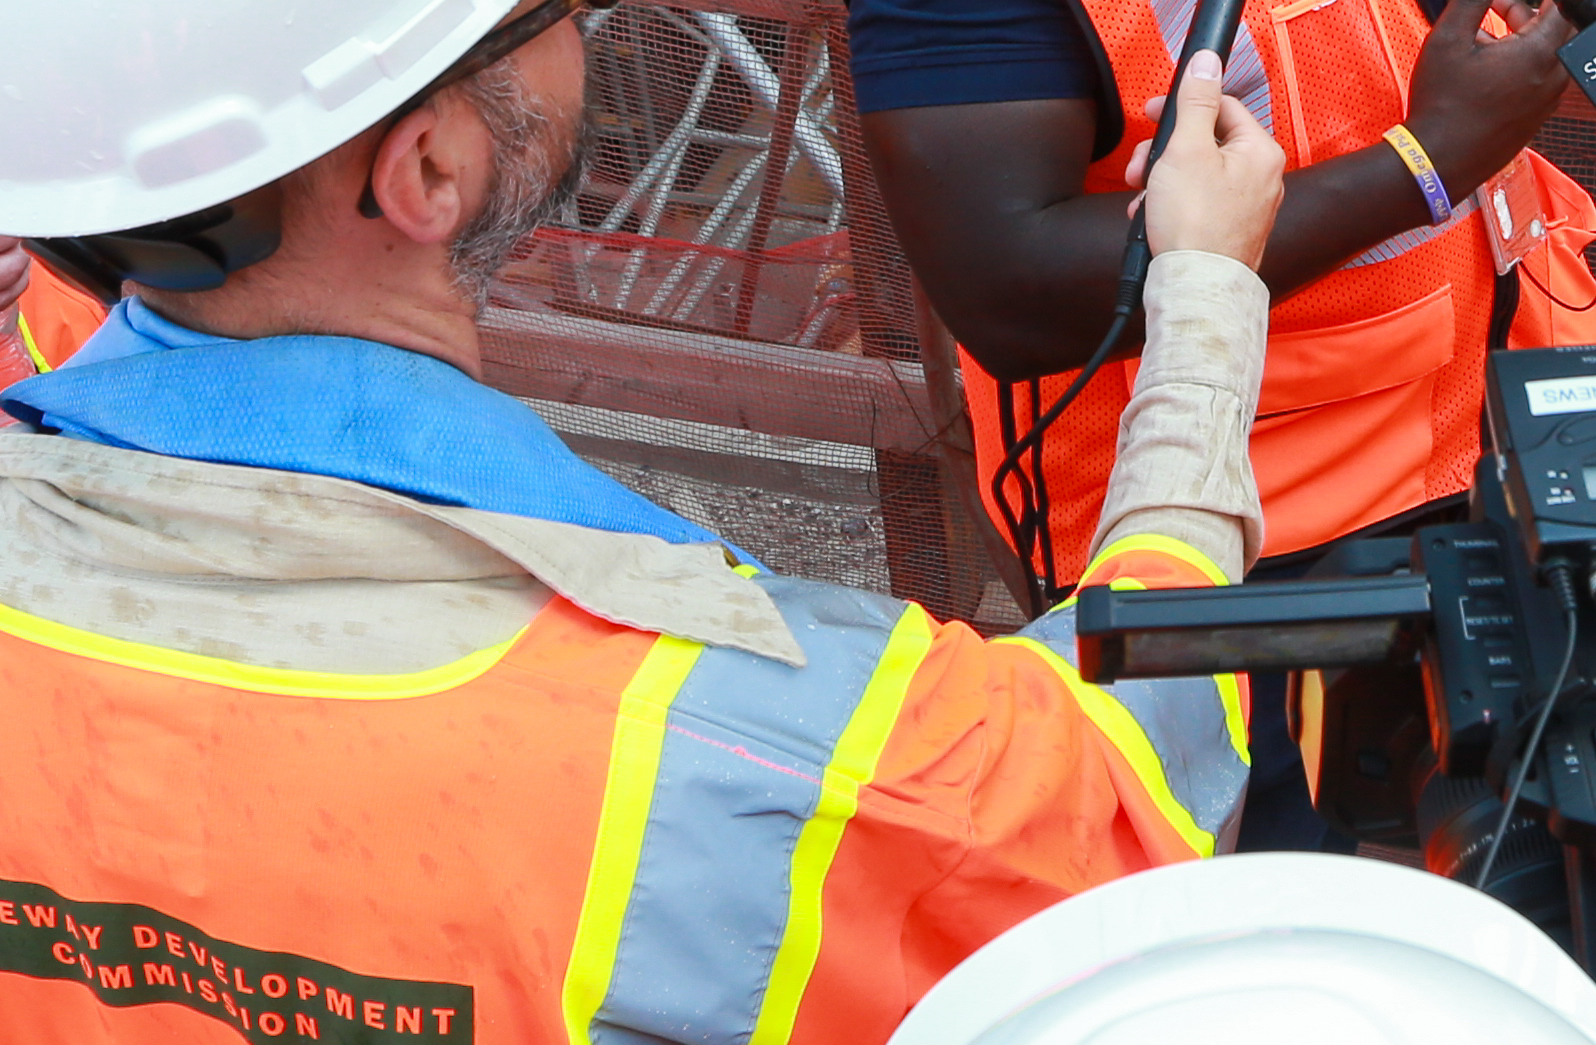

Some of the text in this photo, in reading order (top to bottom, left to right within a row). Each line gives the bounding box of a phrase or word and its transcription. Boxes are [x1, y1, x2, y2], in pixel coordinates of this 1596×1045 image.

[1407, 148, 1437, 194] Omega
[52, 941, 320, 1040] COMMISSION
[133, 924, 457, 1036] DEVELOPMENT
